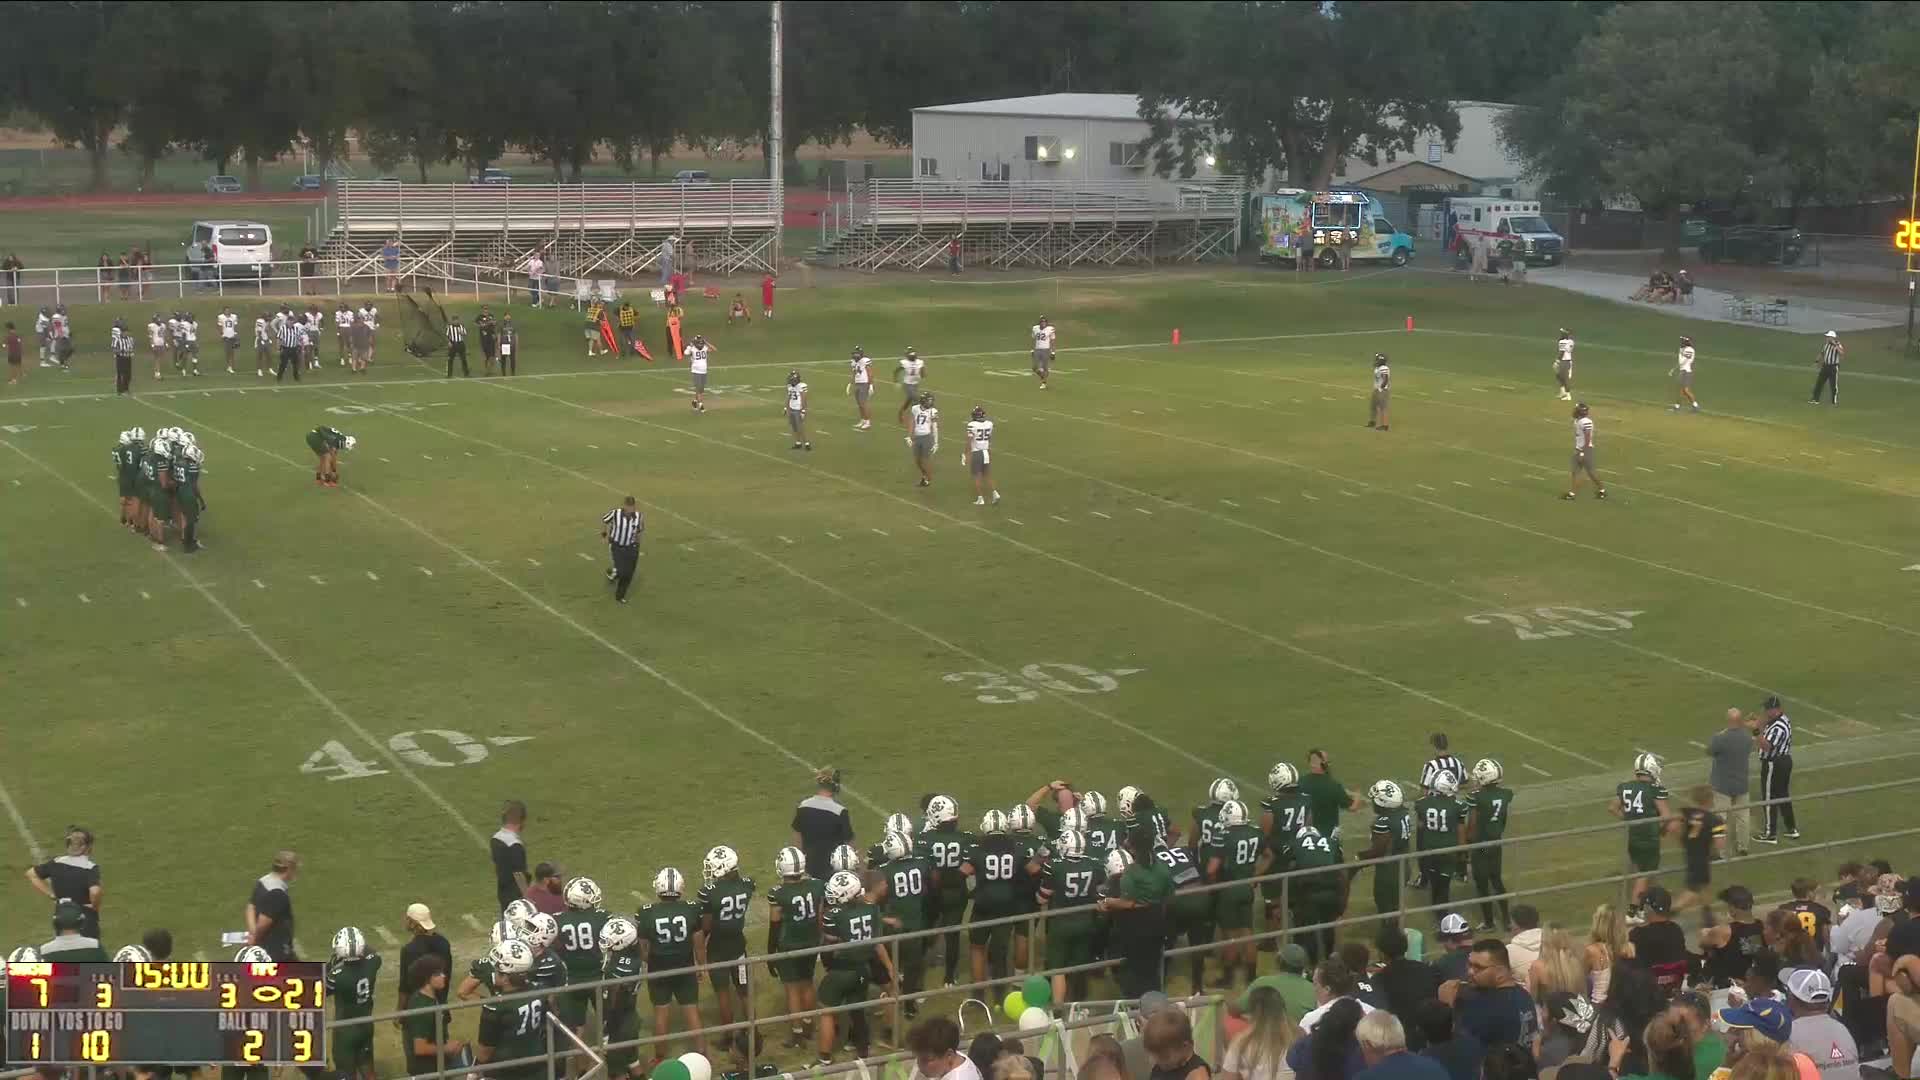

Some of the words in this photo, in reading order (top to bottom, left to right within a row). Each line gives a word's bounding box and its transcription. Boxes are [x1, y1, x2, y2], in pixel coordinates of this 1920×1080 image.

[976, 428, 991, 442] 35
[942, 662, 1121, 704] 30
[298, 729, 492, 781] 40
[1491, 799, 1503, 821] 7
[1622, 789, 1644, 813] 54
[1282, 805, 1306, 832] 74
[1426, 808, 1448, 832] 81
[932, 841, 960, 868] 92
[1156, 847, 1189, 868] 95
[1236, 836, 1259, 864] 87
[1301, 836, 1331, 852] 44
[985, 854, 1014, 880] 98
[894, 868, 922, 898] 80
[1065, 871, 1093, 898] 57
[720, 893, 748, 920] 25
[791, 892, 817, 921] 31
[561, 922, 594, 951] 38
[655, 915, 688, 943] 53
[849, 914, 872, 942] 55
[618, 956, 632, 965] 26
[356, 977, 370, 1004] 9
[517, 1000, 541, 1036] 76
